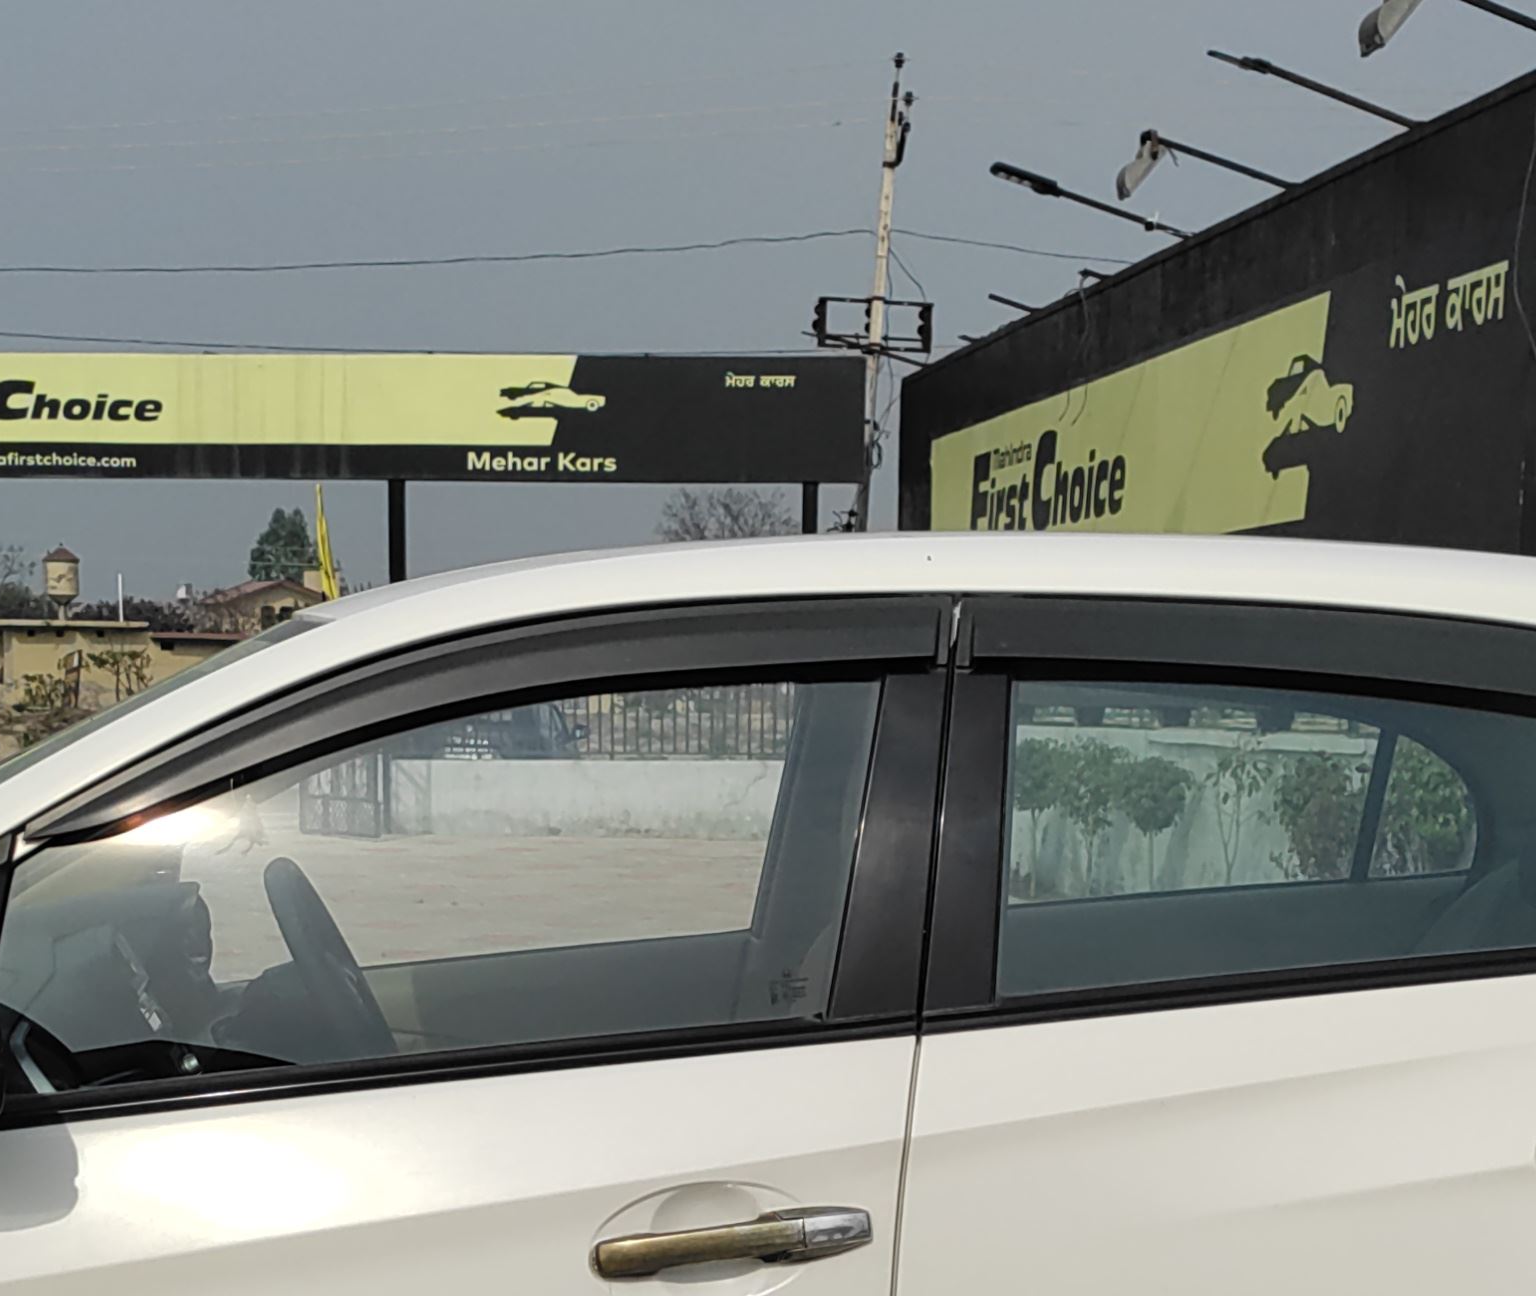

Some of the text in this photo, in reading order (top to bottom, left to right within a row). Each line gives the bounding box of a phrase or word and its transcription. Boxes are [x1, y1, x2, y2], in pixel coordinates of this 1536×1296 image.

[1389, 259, 1510, 349] ਮੇਹਰ ਕਾਰਸ
[466, 451, 617, 472] Mehar Kars
